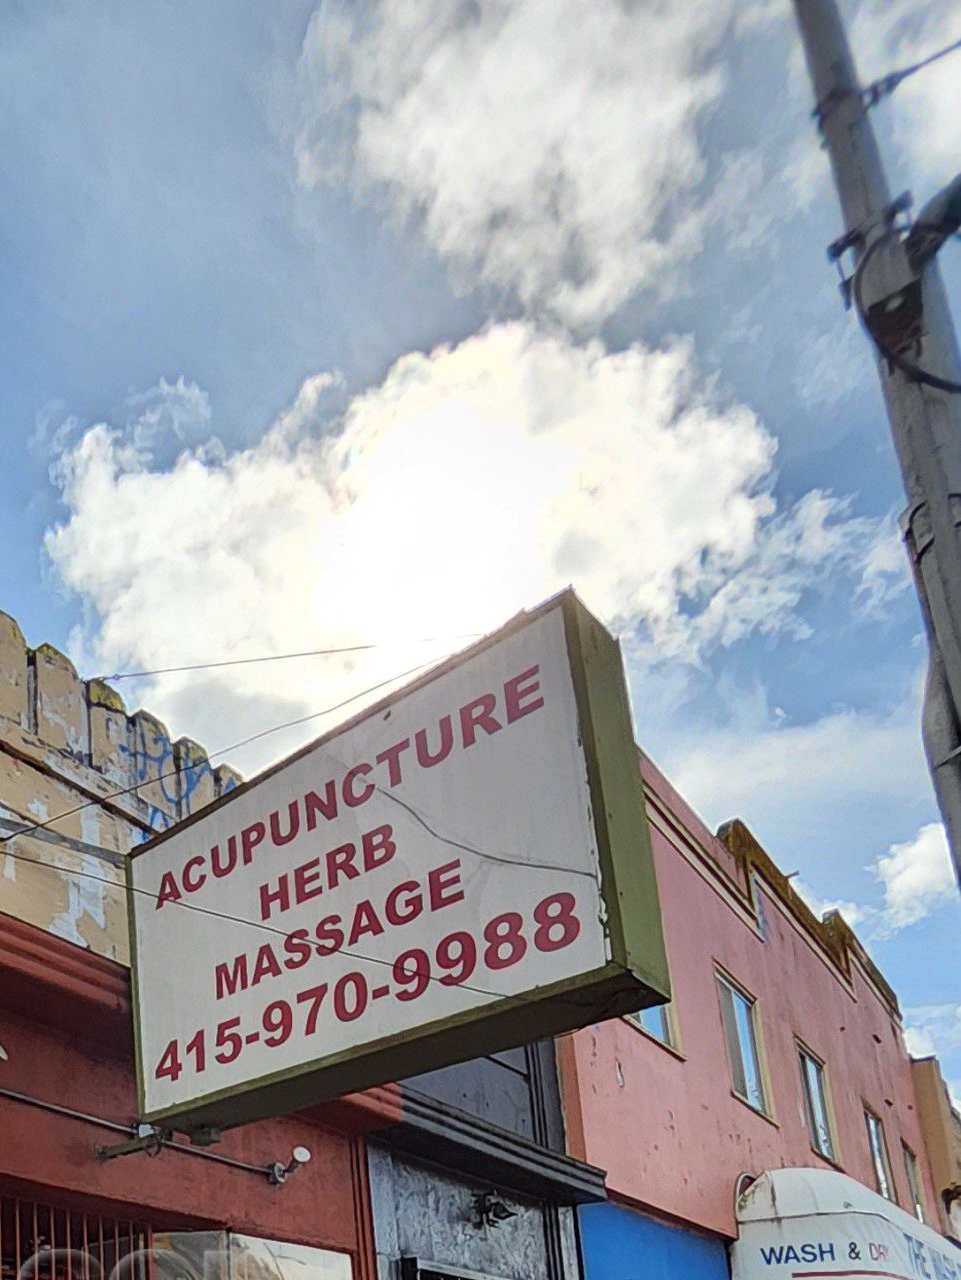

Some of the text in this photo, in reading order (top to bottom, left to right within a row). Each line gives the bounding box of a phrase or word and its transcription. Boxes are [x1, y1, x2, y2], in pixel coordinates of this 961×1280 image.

[155, 664, 545, 910] ACUPUNCTURE
[214, 858, 466, 1000] MASSAGE
[259, 823, 398, 921] HERB
[155, 891, 582, 1083] 415-970-9988
[759, 1243, 835, 1265] WASH
[848, 1242, 861, 1260] &
